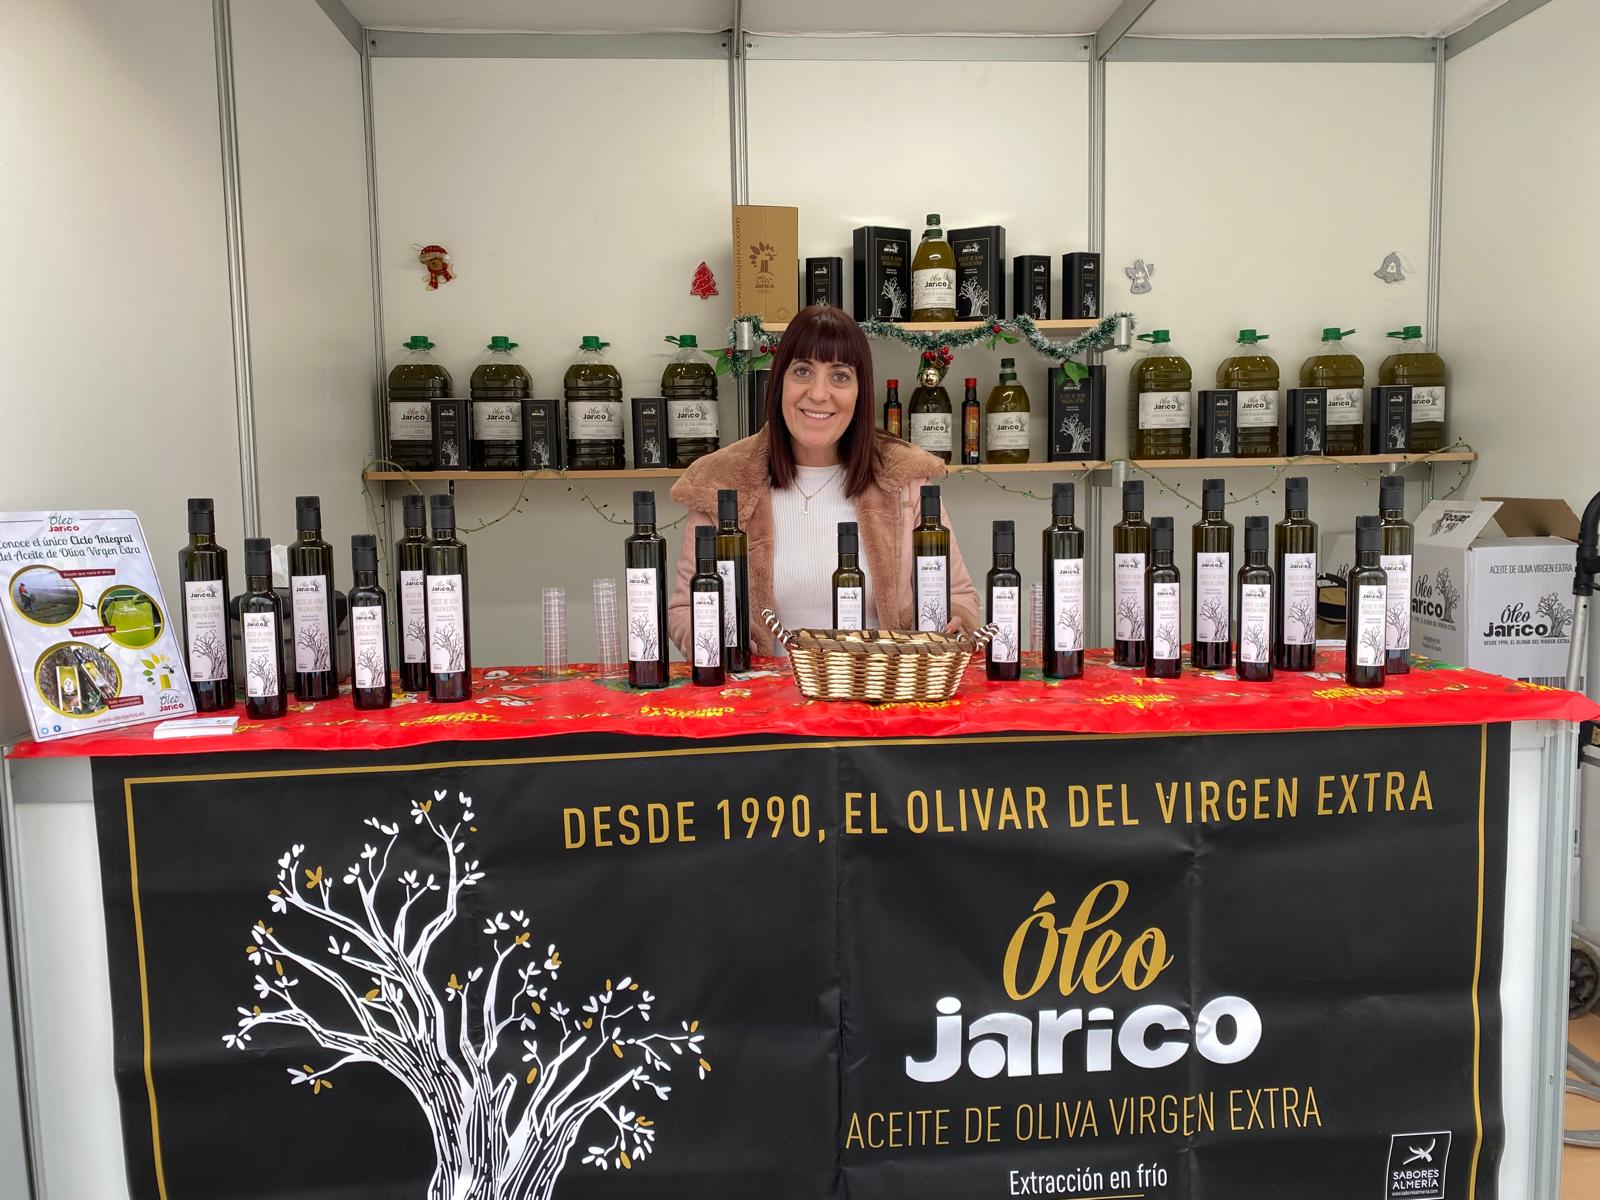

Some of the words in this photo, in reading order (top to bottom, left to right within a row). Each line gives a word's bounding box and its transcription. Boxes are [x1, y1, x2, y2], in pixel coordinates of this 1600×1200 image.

[32, 538, 41, 547] el
[70, 535, 93, 546] Ciclo
[94, 533, 134, 547] Integral
[14, 550, 44, 562] Aceite
[46, 548, 57, 559] de
[58, 547, 86, 559] Oliva
[86, 545, 118, 559] Virgen
[119, 544, 142, 555] Extra
[1490, 565, 1509, 575] ACEITE
[1509, 565, 1517, 574] DE
[1517, 564, 1534, 574] OLIVA
[1533, 563, 1555, 574] VIRGEN
[1555, 563, 1574, 573] EXTRA
[1411, 597, 1443, 618] arico
[1500, 602, 1531, 624] Óleo
[1483, 622, 1549, 637] jarico
[562, 800, 697, 850] DESDE
[716, 793, 826, 844] 1990,
[844, 791, 889, 835] EL
[906, 785, 1050, 835] OLIVAR
[1067, 783, 1140, 828] DEL
[1154, 776, 1299, 825] VIRGEN
[1316, 769, 1434, 817] EXTRA
[1002, 879, 1175, 1001] Óleo
[905, 995, 1263, 1083] jarico
[845, 1109, 950, 1150] ACEITE
[964, 1105, 1002, 1144] DE
[1015, 1100, 1099, 1141] OLIVA
[1108, 1091, 1215, 1138] VIRGEN
[1229, 1085, 1323, 1132] EXTRA
[1009, 1166, 1104, 1196] Extracción
[1109, 1170, 1131, 1189] en
[1136, 1162, 1168, 1188] frío
[1392, 1169, 1440, 1180] SABORES
[1392, 1178, 1439, 1190] ALMERÍA
